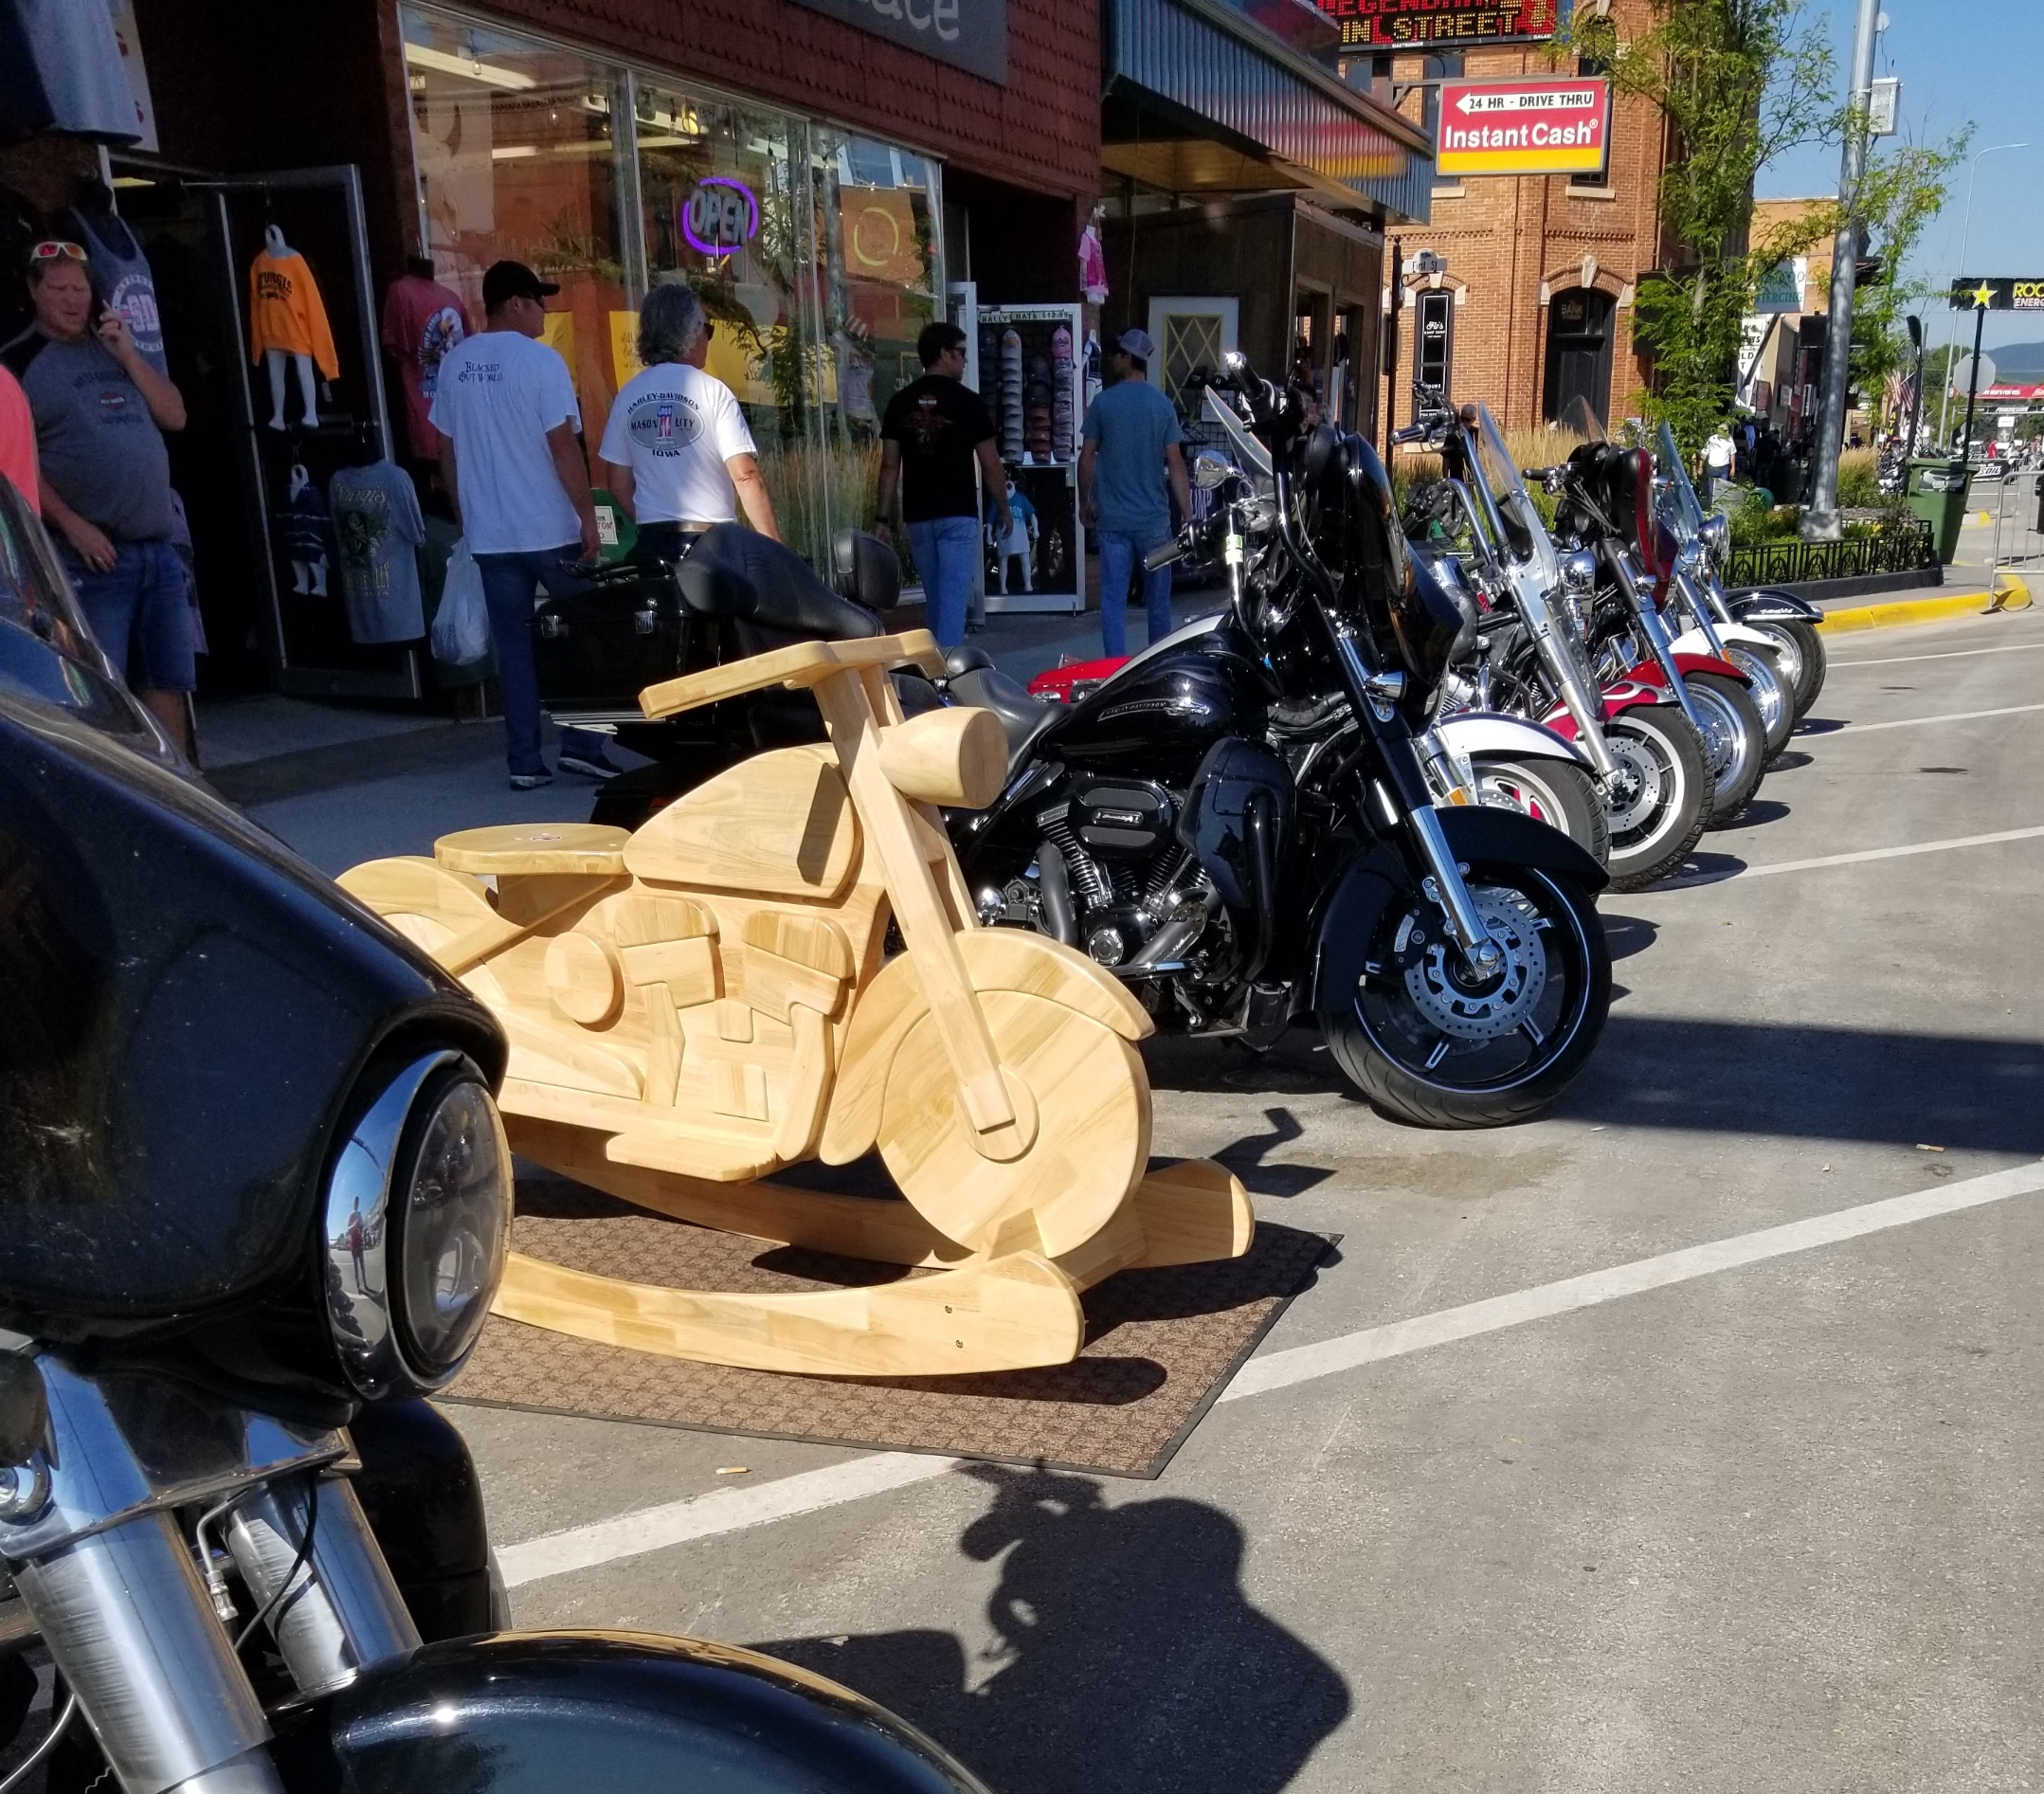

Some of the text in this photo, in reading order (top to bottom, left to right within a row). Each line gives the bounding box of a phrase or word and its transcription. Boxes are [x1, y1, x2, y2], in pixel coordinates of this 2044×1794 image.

[1393, 10, 1519, 39] STREET
[1470, 99, 1482, 109] 24
[1488, 98, 1504, 108] HR
[1519, 96, 1554, 107] DRIVE
[1560, 94, 1592, 105] THRU
[1445, 125, 1528, 148] Instant
[689, 190, 750, 244] OPEN
[1413, 261, 1425, 271] First
[2014, 282, 2044, 298] ROC
[2016, 298, 2044, 307] ENERG
[459, 371, 476, 383] OUT
[627, 391, 699, 415] HARLEY-DAVIDSON
[631, 419, 658, 430] MASON
[676, 417, 695, 428] CITY
[653, 448, 680, 457] IOWA
